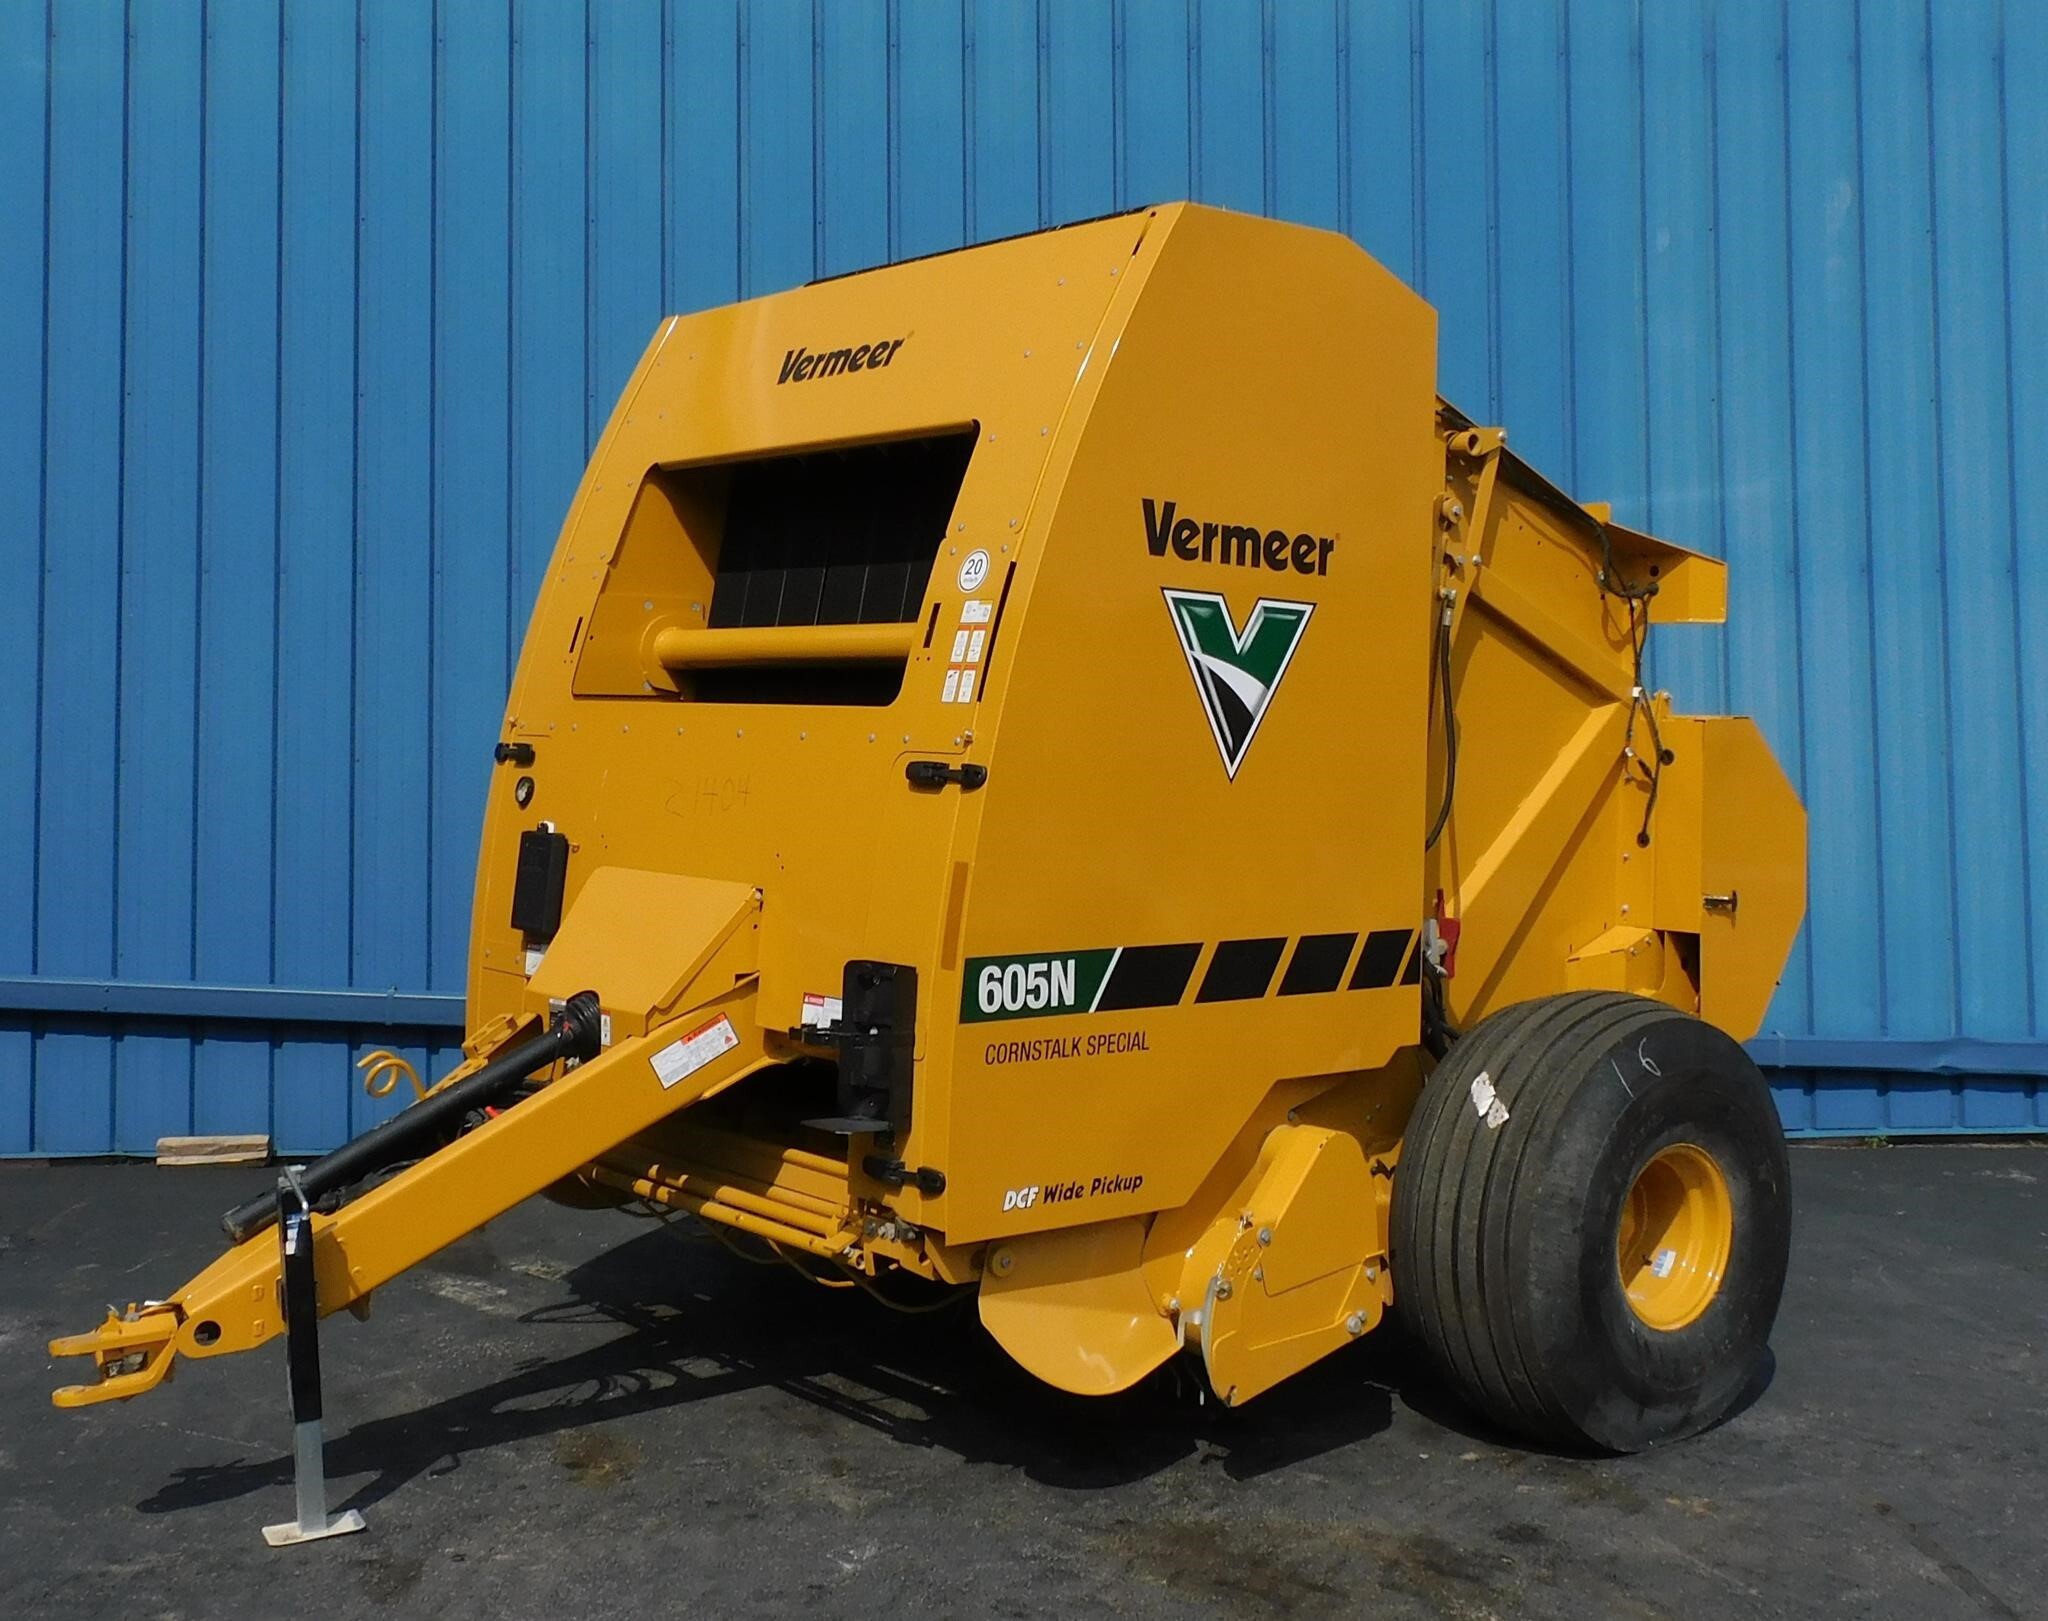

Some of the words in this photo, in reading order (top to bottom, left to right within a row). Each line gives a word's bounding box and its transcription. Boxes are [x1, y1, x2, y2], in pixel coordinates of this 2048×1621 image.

[776, 337, 905, 385] Vermeer
[1141, 497, 1335, 577] Vermeer
[964, 558, 984, 575] 20
[978, 958, 1076, 1014] 605N
[984, 1036, 1082, 1066] CORNSTALK
[1086, 1030, 1150, 1056] SPECIAL
[1002, 1185, 1040, 1213] DCF
[1043, 1180, 1085, 1204] Wide
[1090, 1173, 1143, 1197] Pickup
